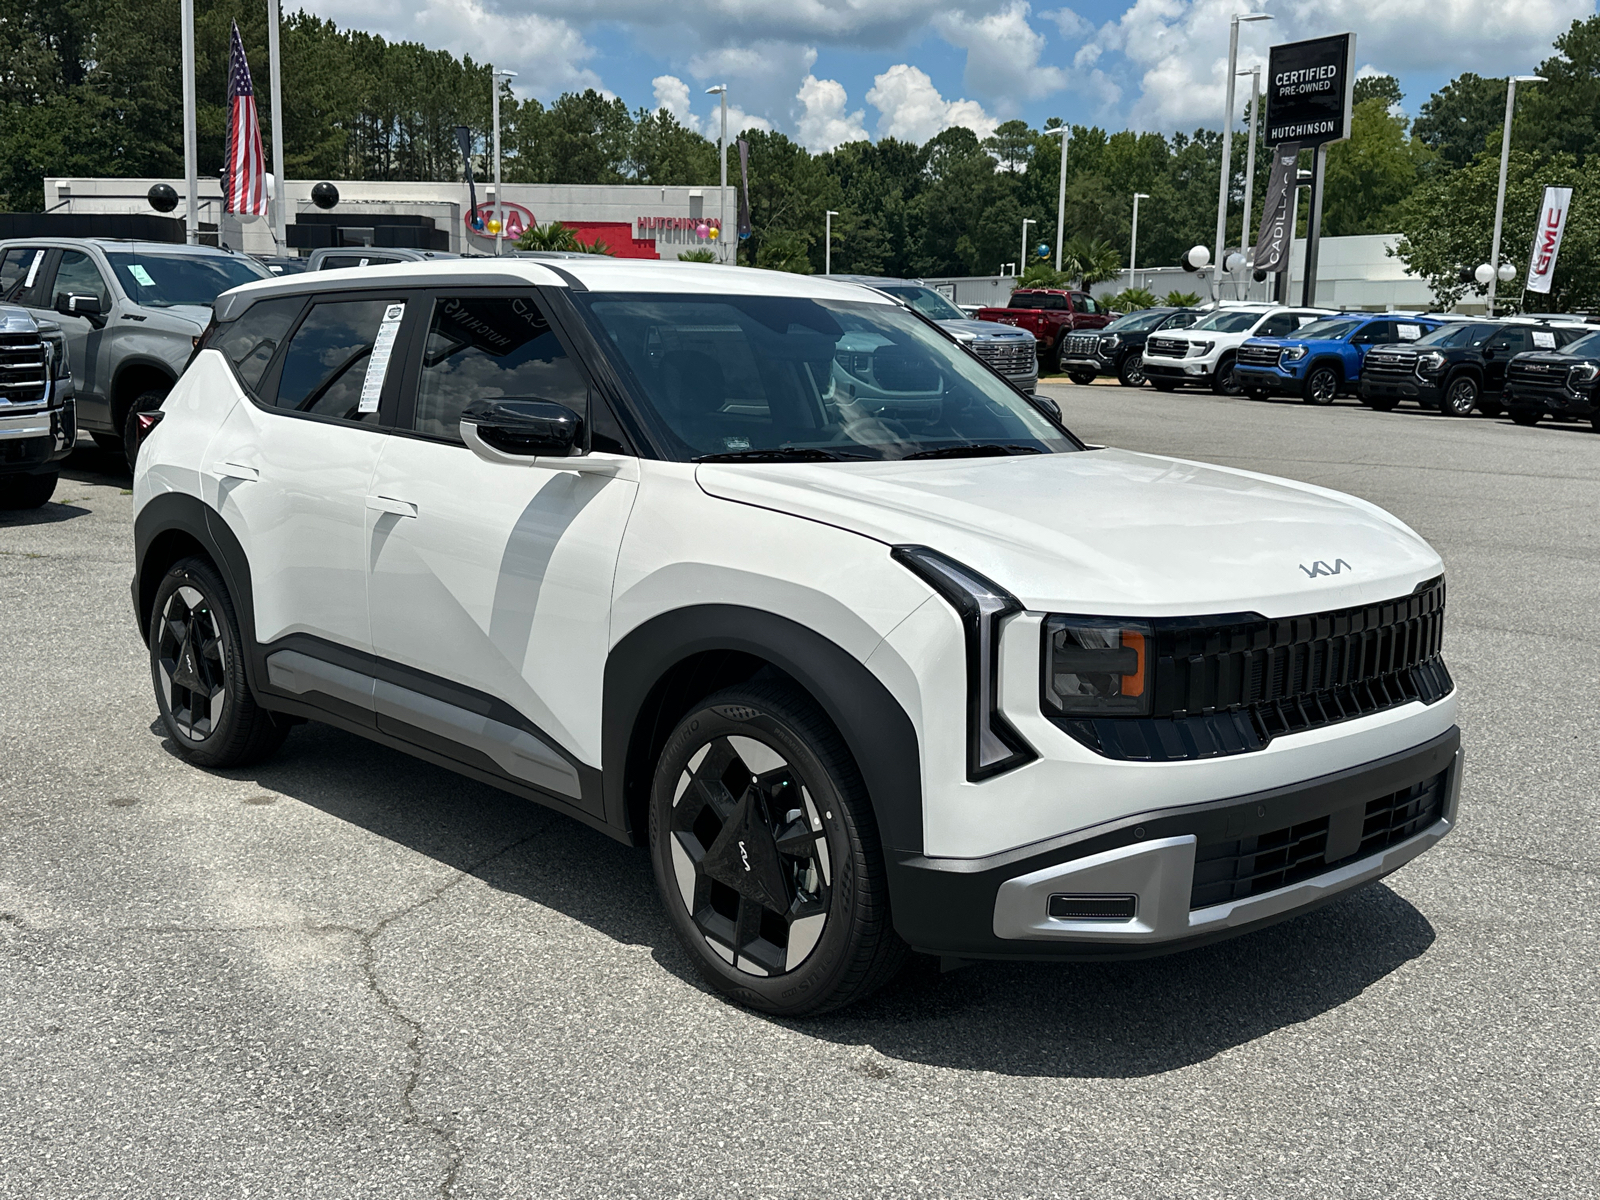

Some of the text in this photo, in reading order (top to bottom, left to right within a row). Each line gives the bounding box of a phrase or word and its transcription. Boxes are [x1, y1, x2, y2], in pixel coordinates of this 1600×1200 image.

[1275, 64, 1337, 86] CERTIFIED
[1279, 80, 1331, 97] PRE-OWNED
[1271, 120, 1334, 139] HUTCHINSON
[1535, 208, 1562, 275] GMC
[1299, 558, 1352, 579] KIA
